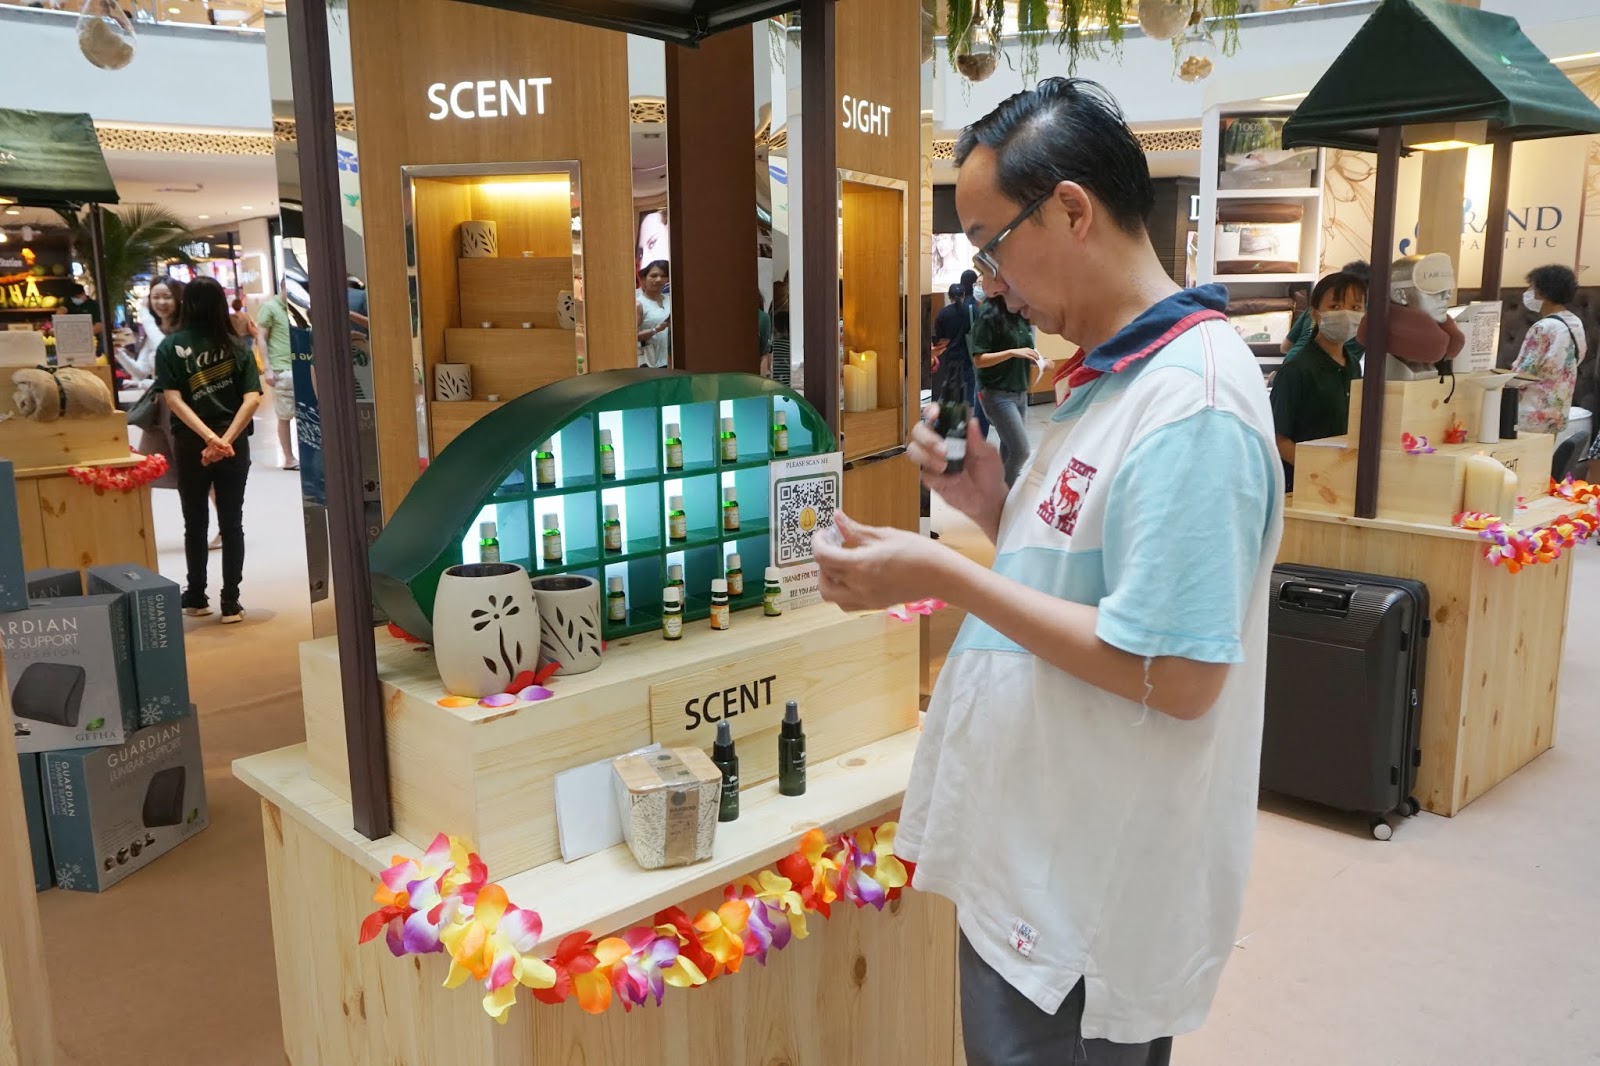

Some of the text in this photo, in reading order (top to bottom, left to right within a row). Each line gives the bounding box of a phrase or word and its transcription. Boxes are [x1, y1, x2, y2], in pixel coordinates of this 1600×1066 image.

[427, 77, 552, 121] SCENT
[842, 94, 891, 137] SIGHT
[1239, 122, 1264, 132] 100%
[1461, 235, 1557, 250] PAIFIC
[786, 460, 805, 469] PLEASE
[782, 573, 801, 584] THANKS
[801, 571, 811, 581] FOR
[790, 589, 798, 598] SEE
[798, 587, 809, 595] YOU
[155, 593, 168, 648] GUARDIAN
[19, 633, 79, 649] SUPPORT
[149, 621, 159, 649] SUPPORT
[685, 675, 776, 730] SCENT
[75, 731, 117, 741] GETHA
[107, 722, 181, 767] GUARDIAN
[109, 736, 182, 782] LUMBAR SUPPORT
[61, 761, 75, 816] GUARDIAN
